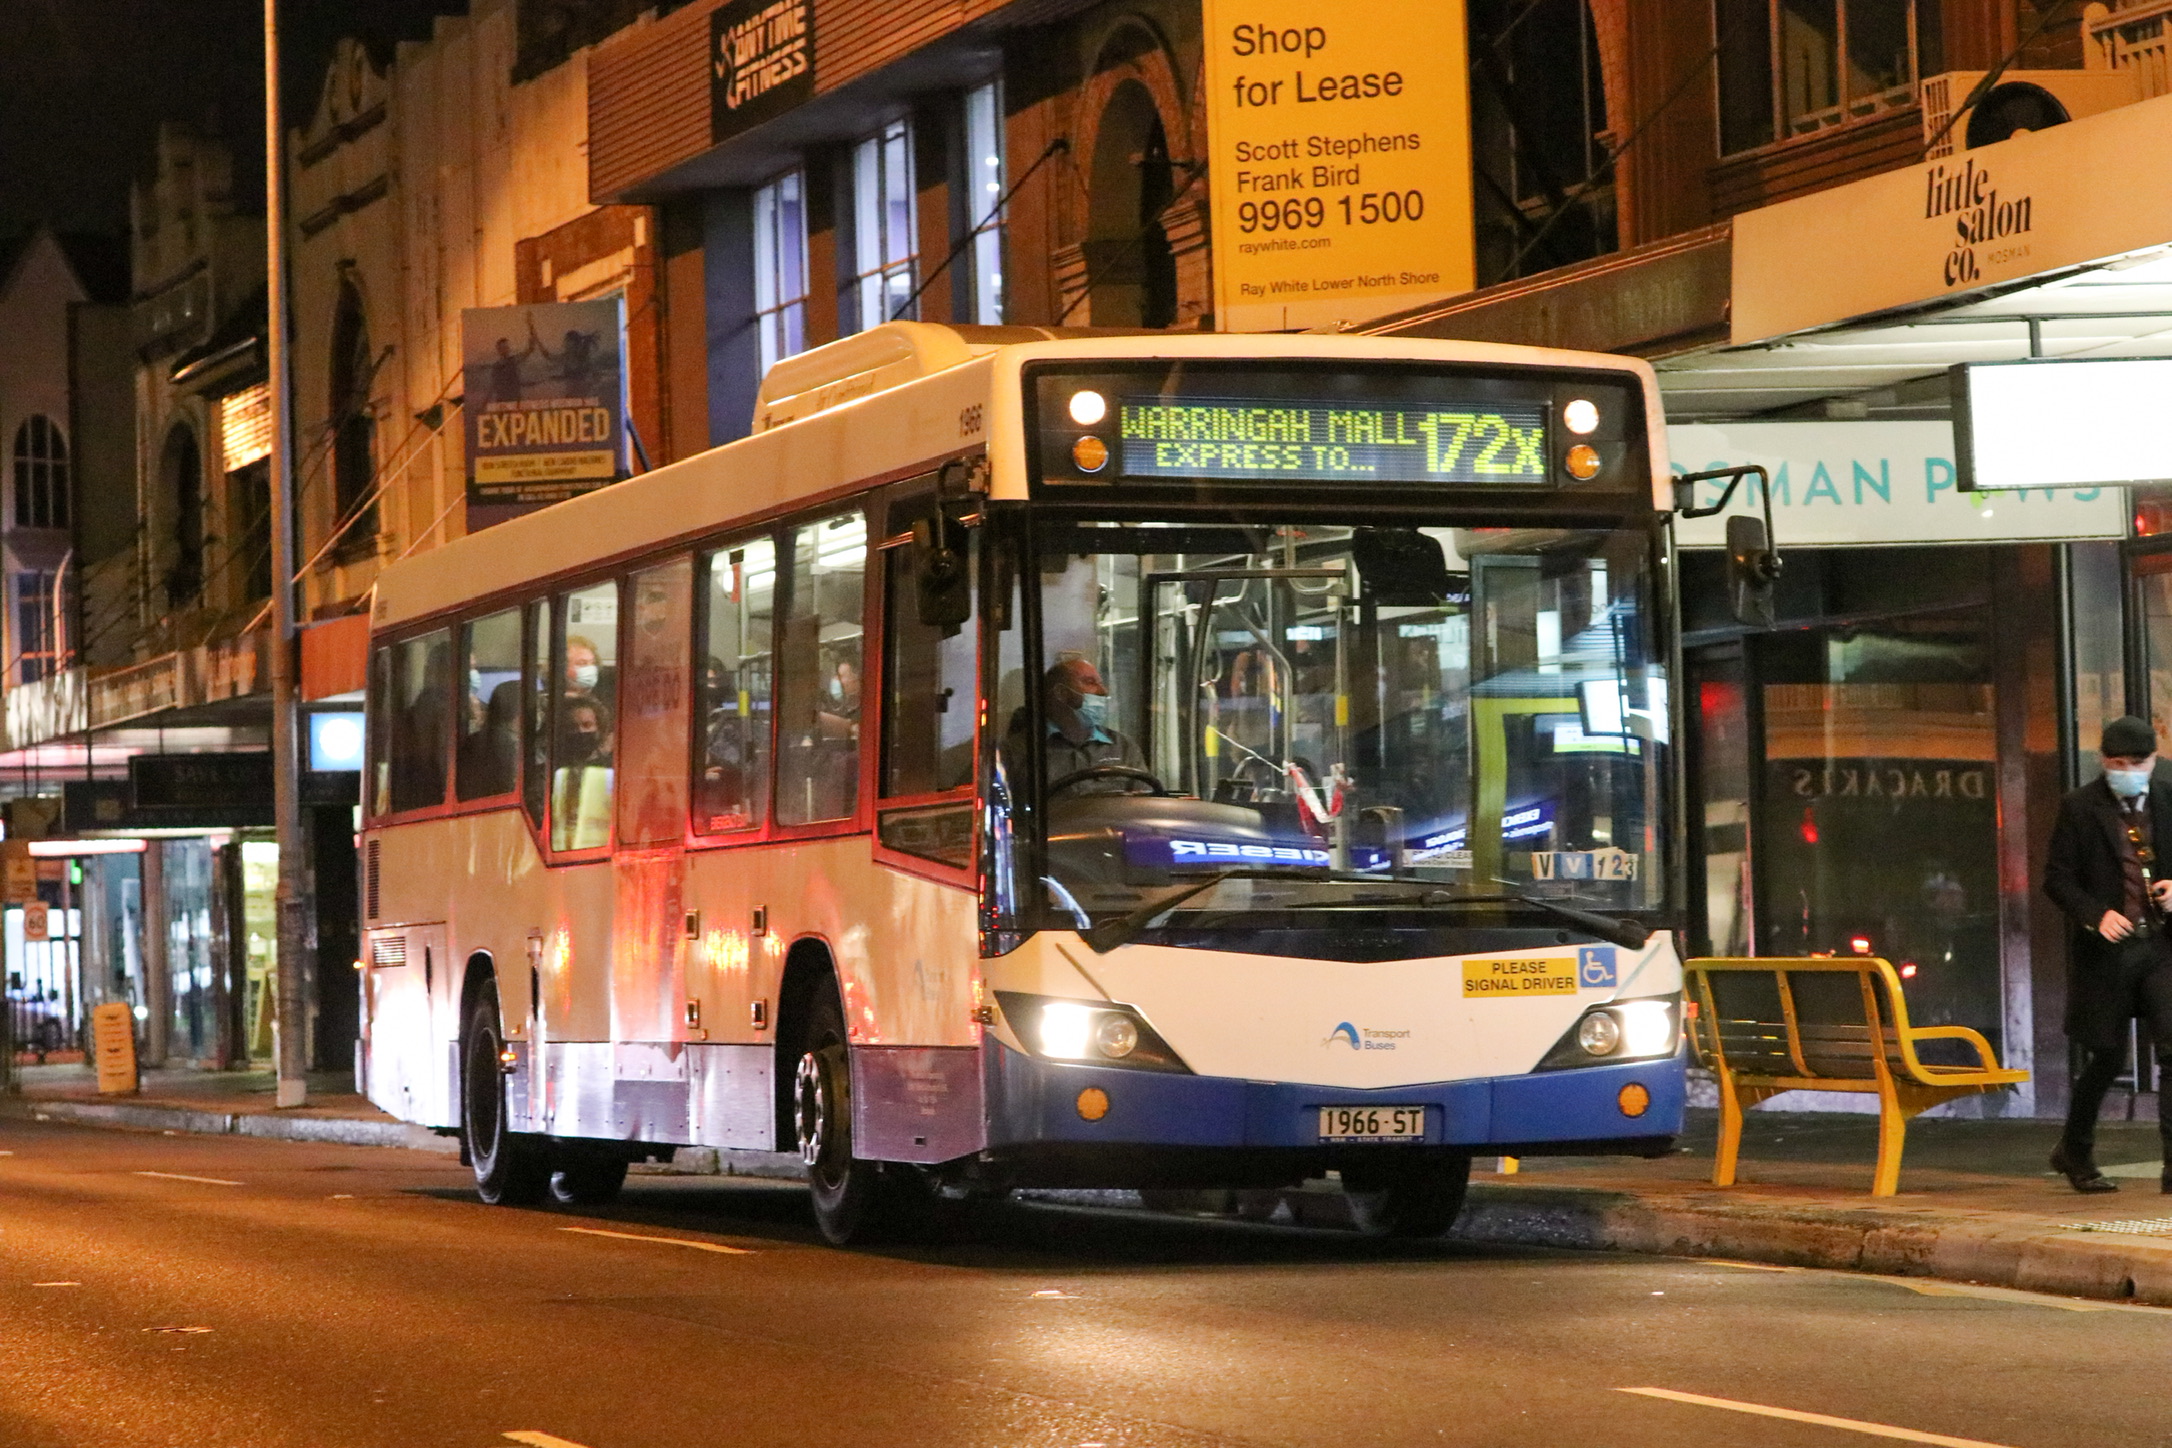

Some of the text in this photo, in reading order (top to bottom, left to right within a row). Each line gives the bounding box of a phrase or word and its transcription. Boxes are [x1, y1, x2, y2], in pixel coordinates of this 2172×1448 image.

[1232, 23, 1326, 58] Shop
[736, 37, 808, 106] FITNESS
[1233, 71, 1403, 108] for Lease
[1235, 132, 1421, 162] Scott Stephens
[1237, 163, 1360, 193] Frank Bird
[1925, 157, 1988, 219] little
[1238, 189, 1424, 233] 9969 1500
[1955, 189, 2031, 248] salon
[1239, 237, 1331, 255] raywhite.com
[1986, 245, 2032, 264] MOSMAN
[1944, 247, 1980, 287] co.
[1240, 271, 1440, 297] Ray White Lower North Shore
[477, 407, 611, 448] EXPANDED
[959, 403, 984, 438] 1966
[1121, 406, 1417, 444] WARRINGAH MALL
[1156, 443, 1302, 469] EXPRESS
[1465, 976, 1575, 992] SIGNAL DRIVER
[1492, 961, 1547, 975] PLEASE
[1363, 1028, 1411, 1040] Transport
[1364, 1040, 1396, 1050] Buses
